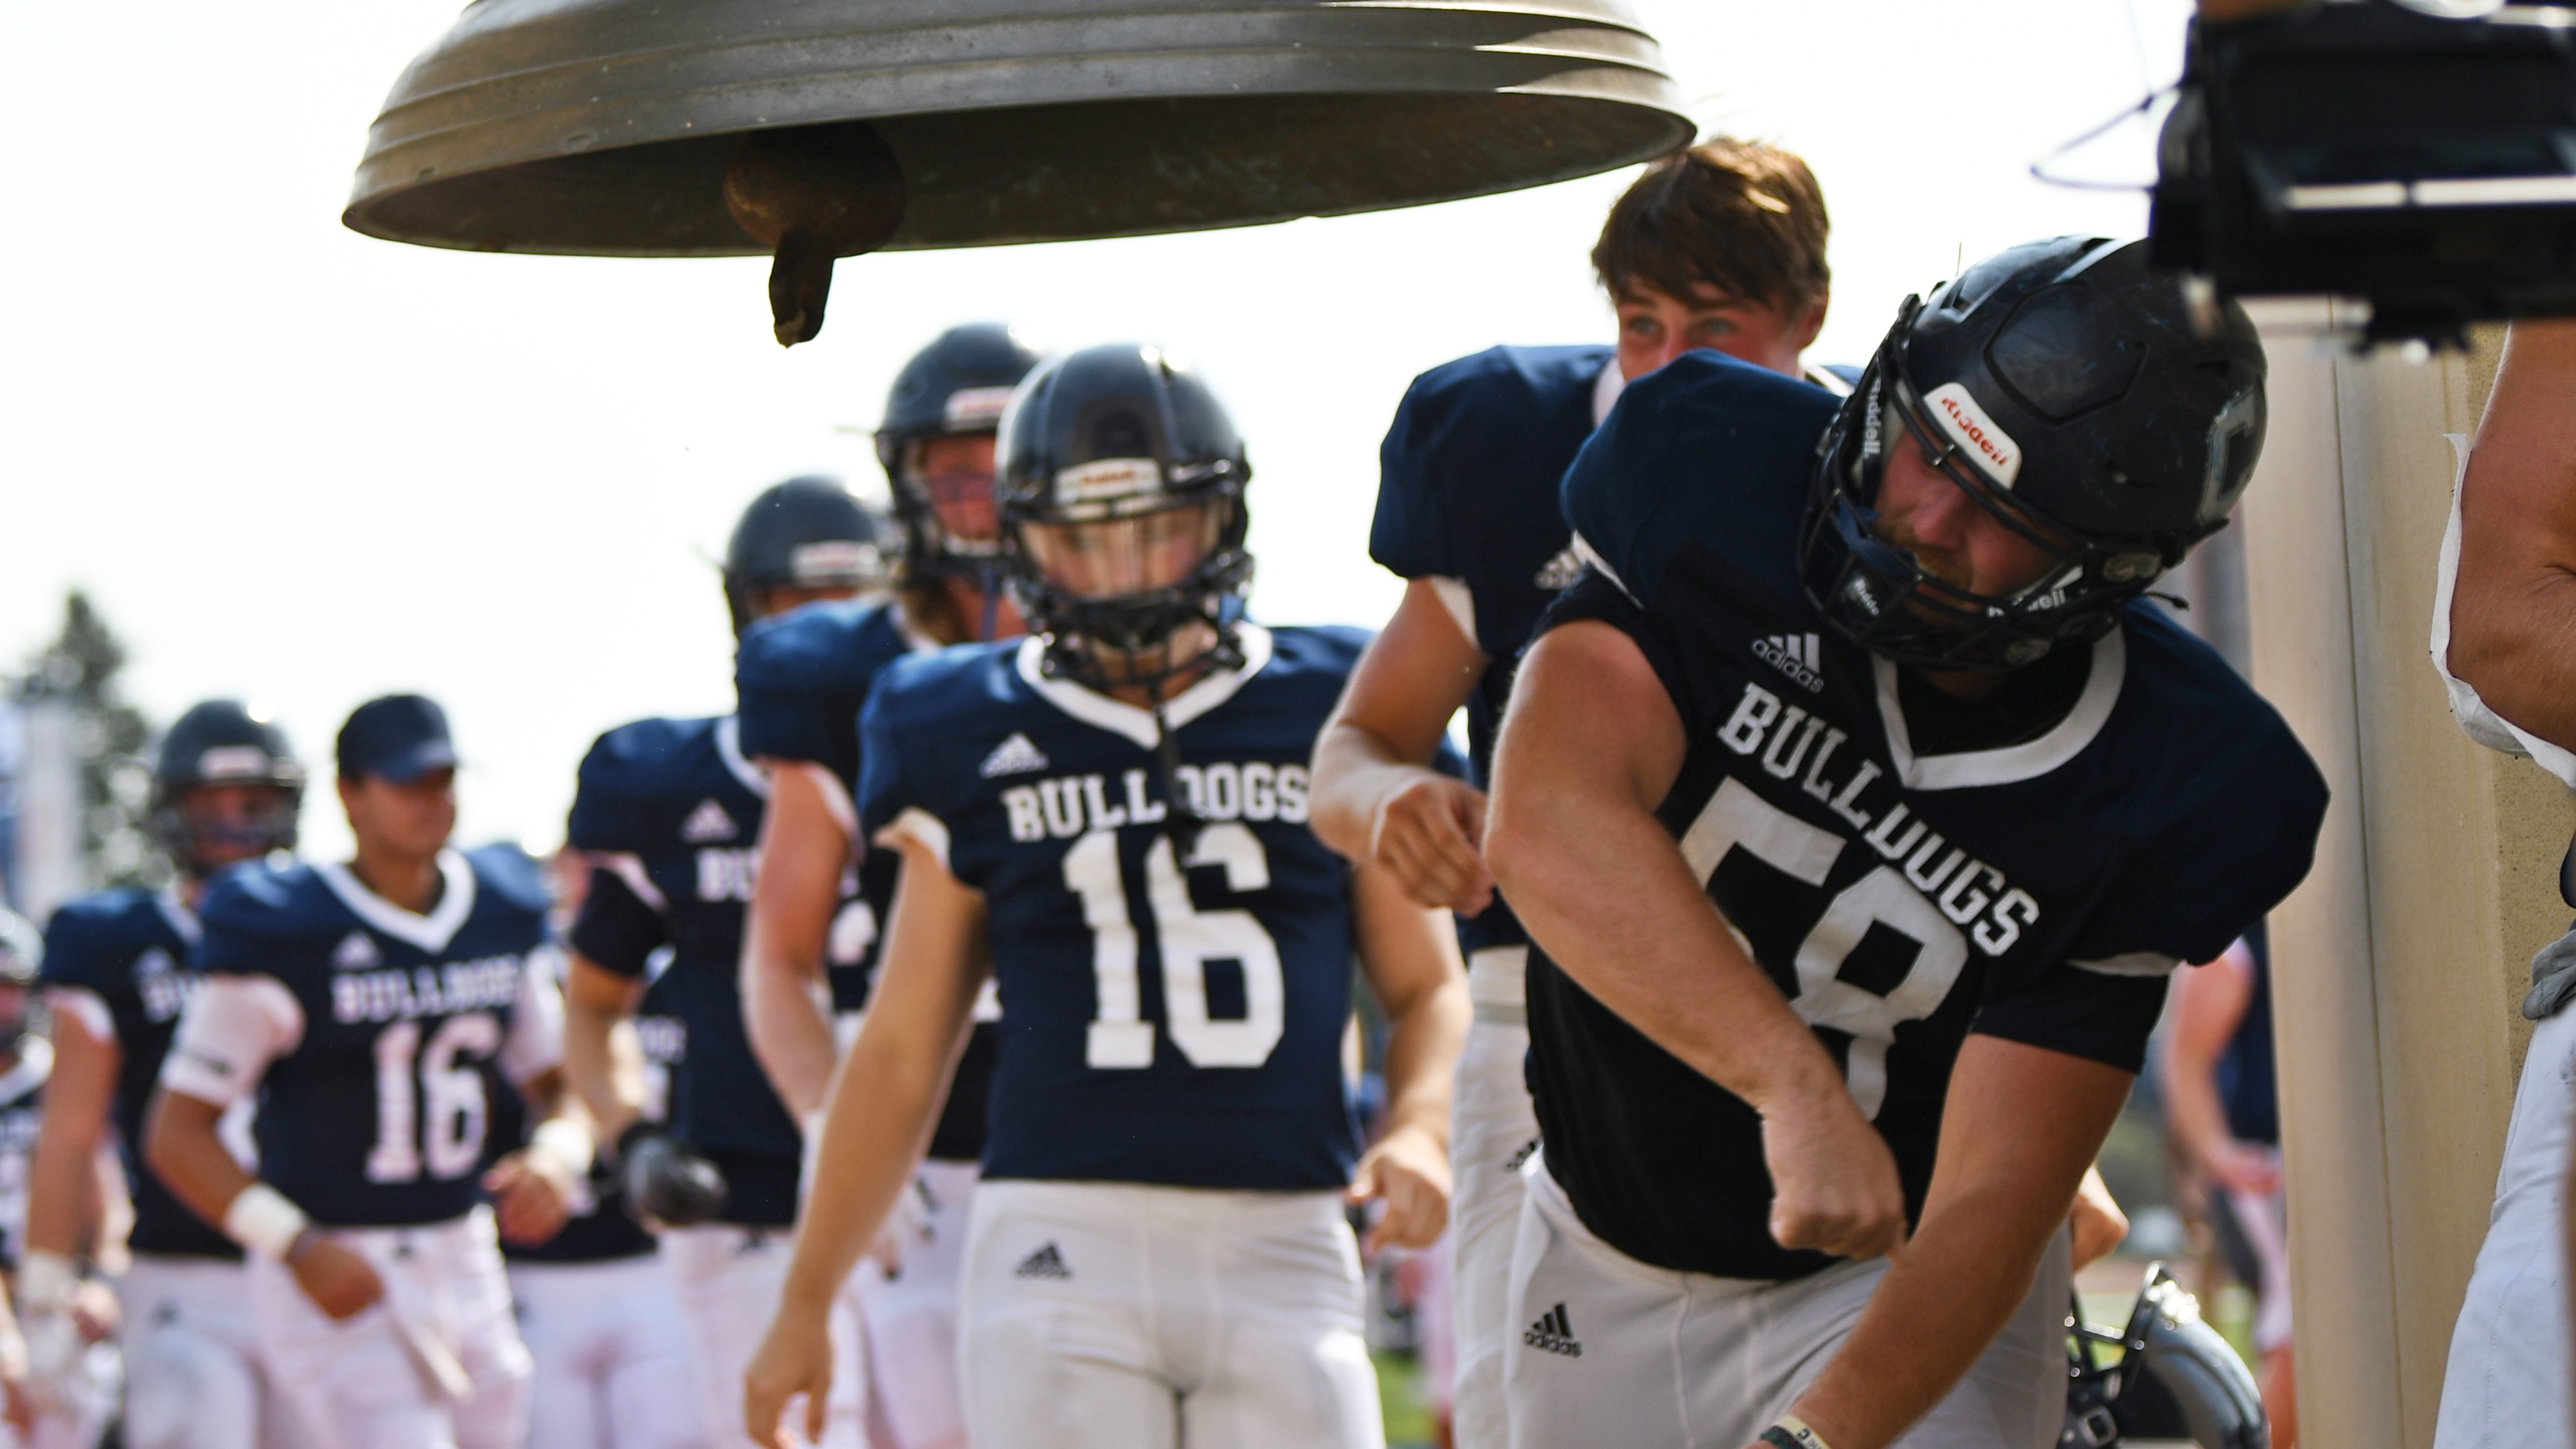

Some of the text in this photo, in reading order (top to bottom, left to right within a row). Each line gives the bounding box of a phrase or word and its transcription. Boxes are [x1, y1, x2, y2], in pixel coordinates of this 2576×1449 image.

[1750, 638, 1824, 693] adidas
[1062, 823, 1285, 1070] 16
[366, 1014, 501, 1182] 16
